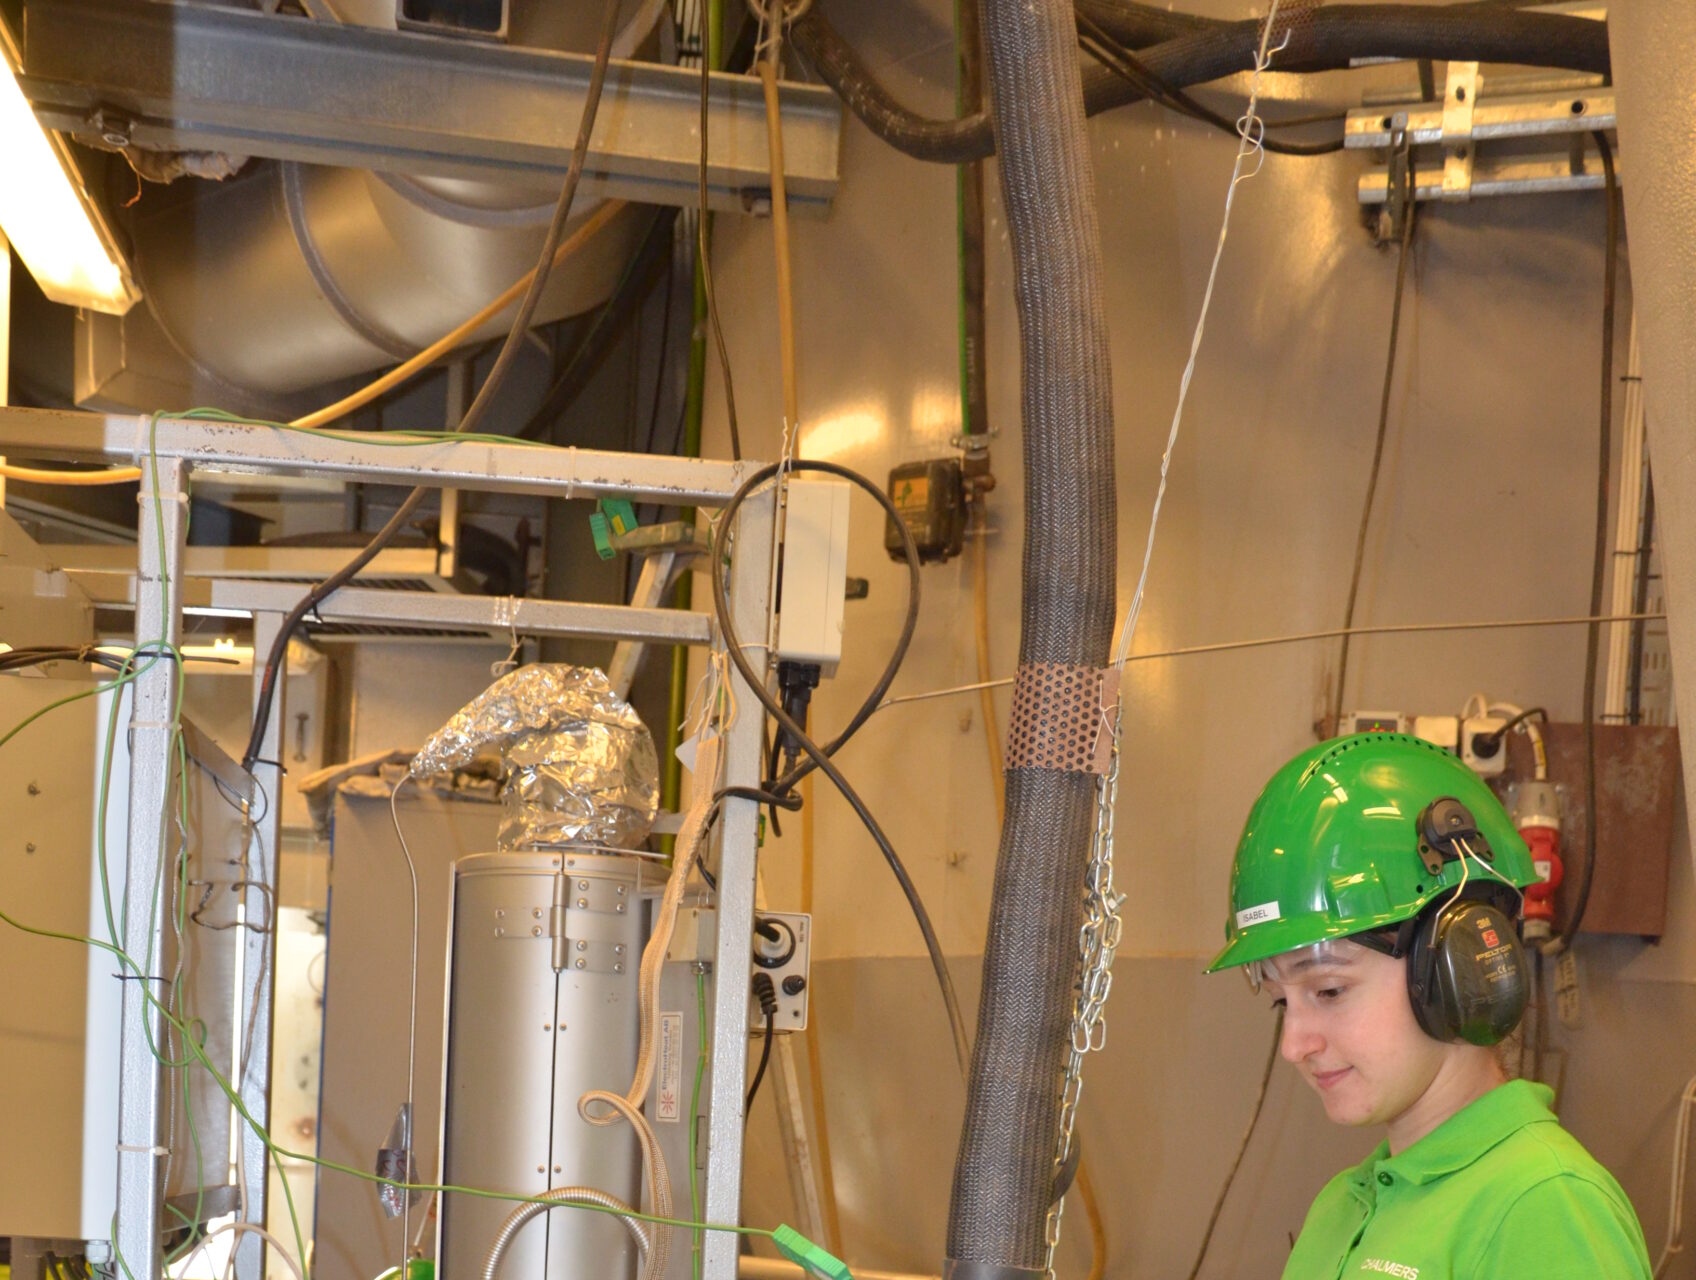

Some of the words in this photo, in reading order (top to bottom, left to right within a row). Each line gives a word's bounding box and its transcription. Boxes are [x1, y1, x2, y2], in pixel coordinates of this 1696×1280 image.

[1242, 909, 1269, 923] ISABEL
[1475, 916, 1492, 930] 3M
[1475, 943, 1513, 962] PELTOR
